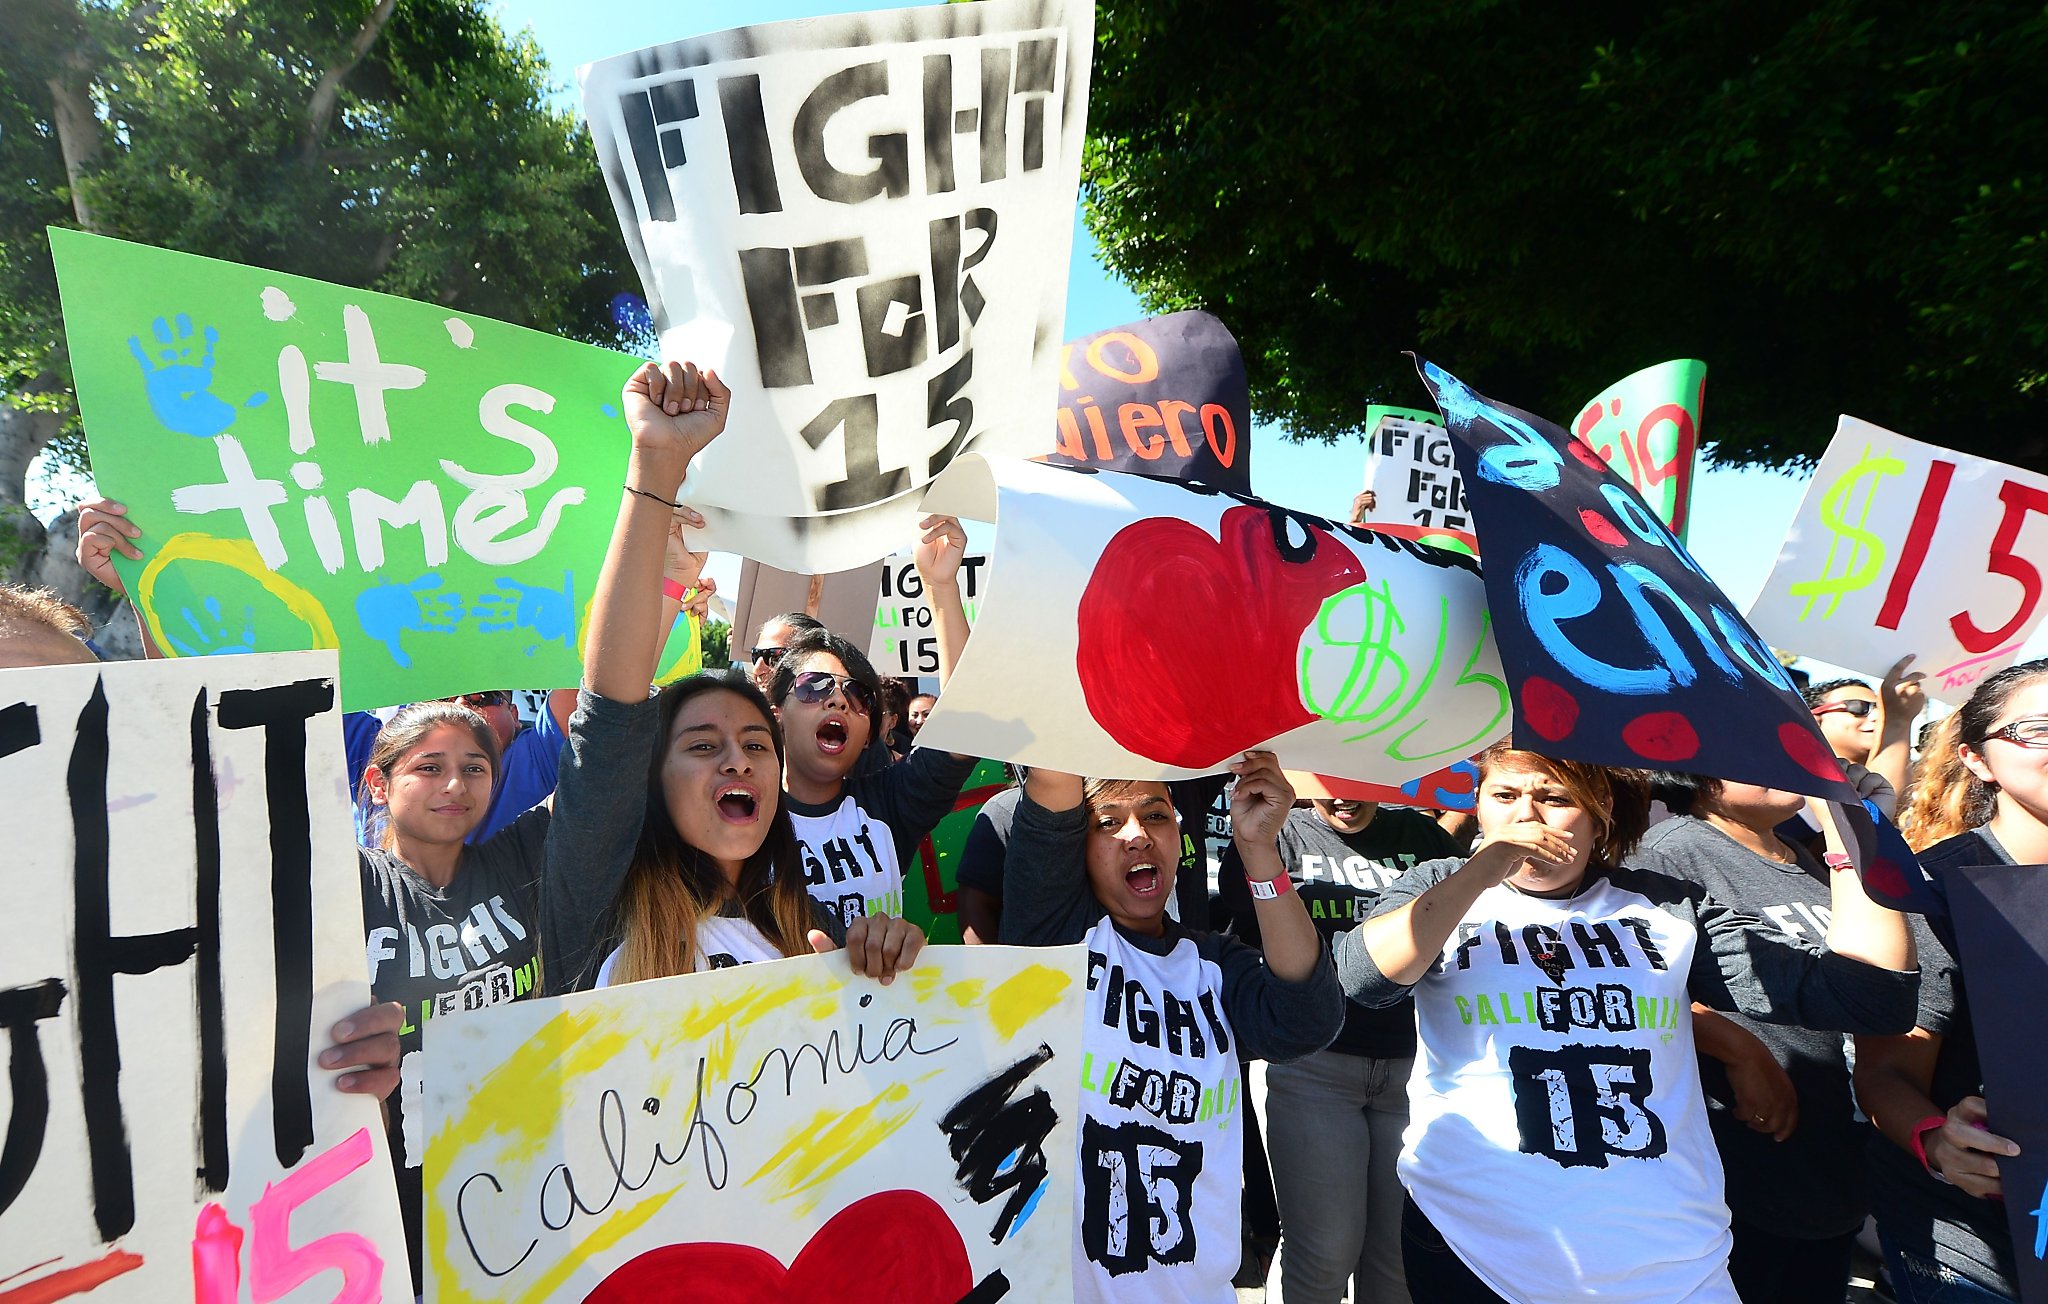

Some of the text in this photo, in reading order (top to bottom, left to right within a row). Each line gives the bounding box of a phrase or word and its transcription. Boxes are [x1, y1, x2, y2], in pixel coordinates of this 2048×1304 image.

[618, 36, 1059, 222] FIGHT
[260, 285, 560, 491] it's
[798, 349, 974, 511] 15
[1382, 428, 1458, 471] FIG
[1789, 442, 2048, 654] $15
[1302, 578, 1510, 762] $15
[1454, 985, 1679, 1030] CALIFORNIA
[1456, 916, 1669, 973] FIGHT
[1531, 1063, 1653, 1153] 15
[192, 1128, 383, 1304] 15
[1098, 1143, 1187, 1258] 15
